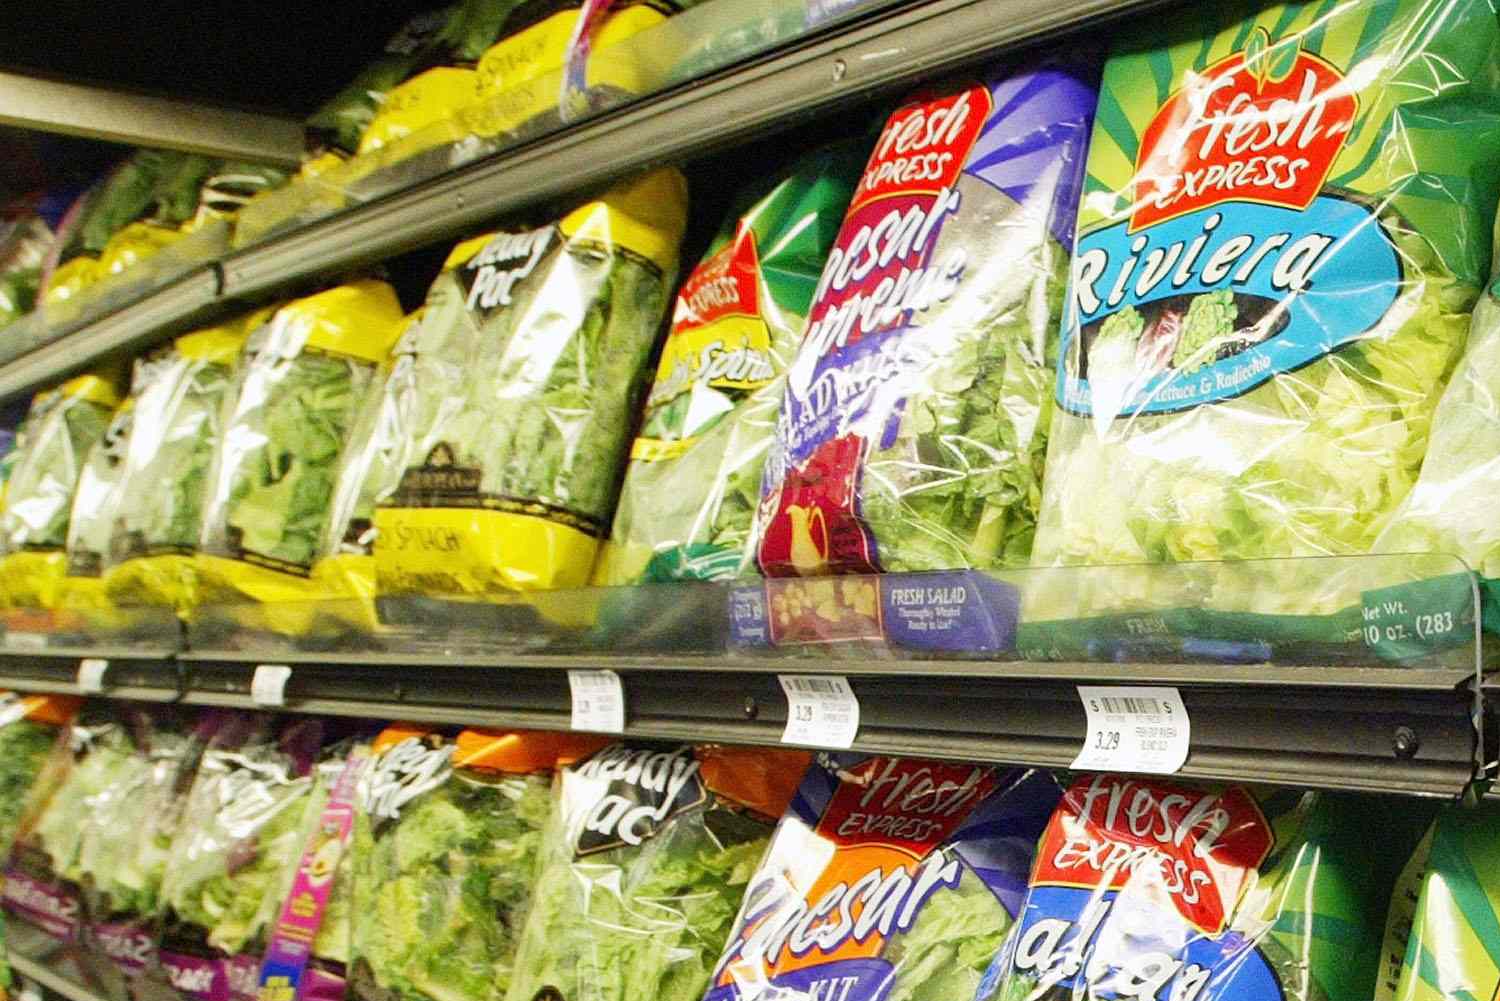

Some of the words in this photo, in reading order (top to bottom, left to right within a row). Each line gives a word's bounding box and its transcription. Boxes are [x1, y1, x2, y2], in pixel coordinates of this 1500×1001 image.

[877, 90, 971, 161] resh
[863, 152, 953, 190] XPRESS
[1150, 155, 1310, 209] EXPRESS
[1075, 213, 1336, 316] Riviera
[891, 587, 924, 605] FRESH
[1415, 611, 1454, 641] (283
[574, 744, 700, 822] eady
[837, 812, 944, 842] EXPRESS
[1077, 775, 1232, 858] Fresh
